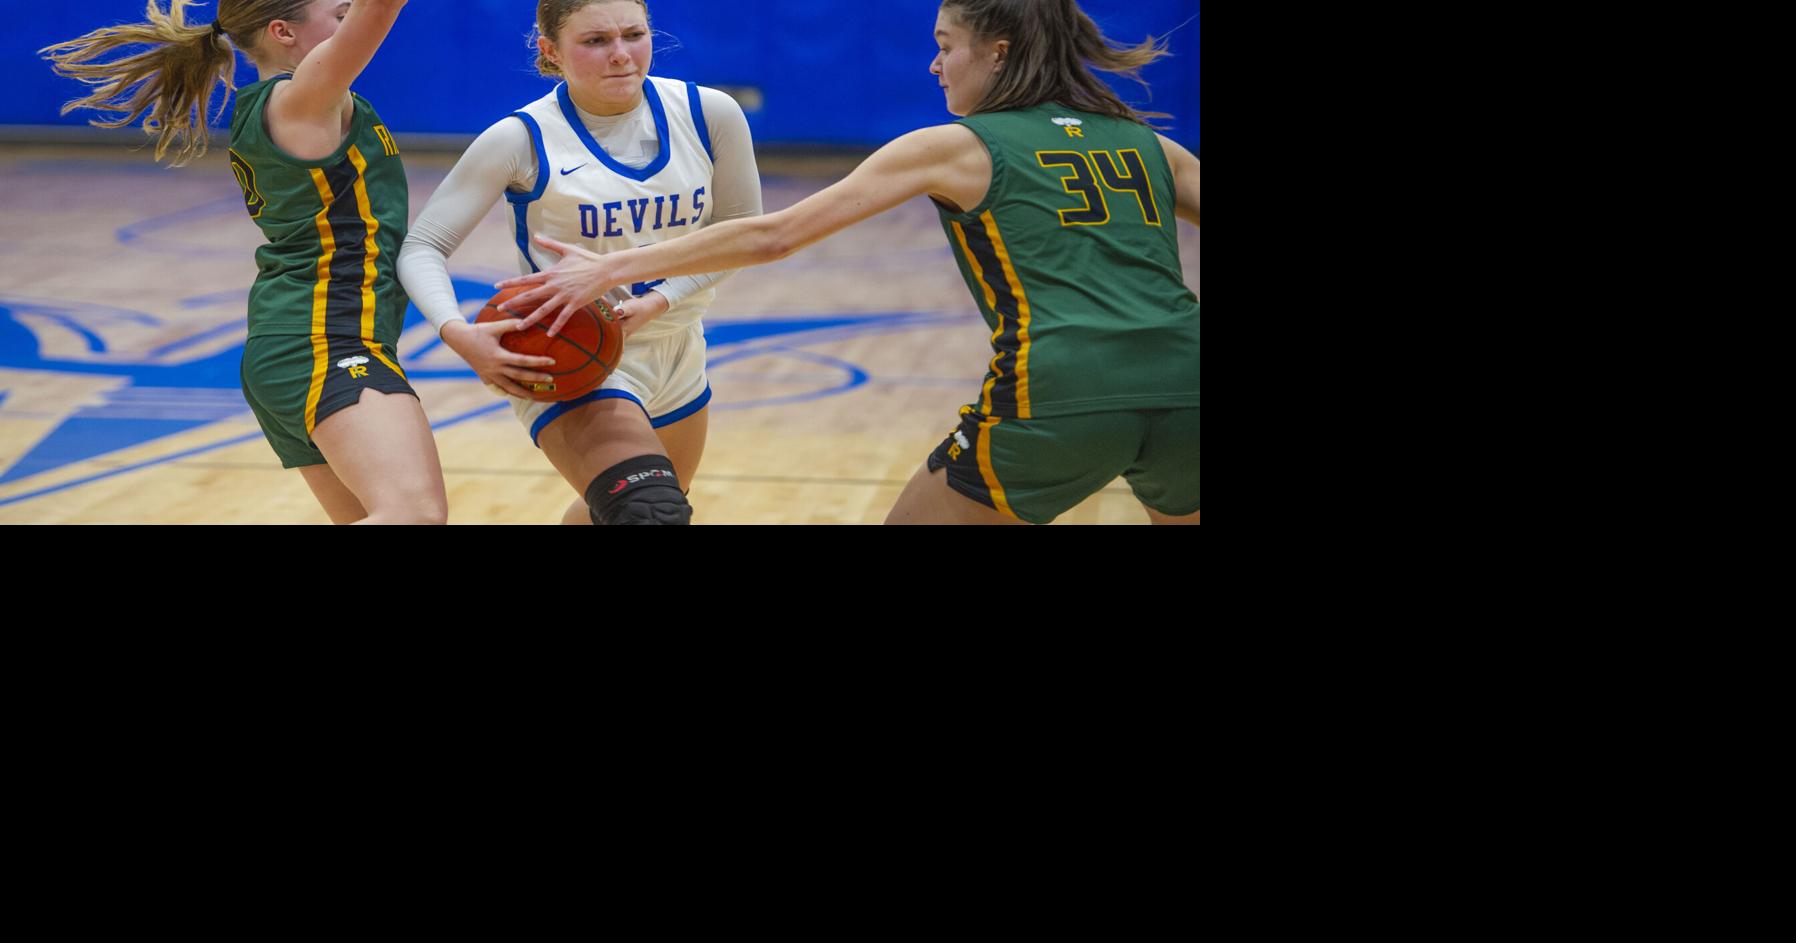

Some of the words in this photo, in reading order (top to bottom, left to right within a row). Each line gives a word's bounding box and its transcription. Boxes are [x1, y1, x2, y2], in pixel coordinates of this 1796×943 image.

[1063, 125, 1085, 138] R
[578, 186, 705, 239] DEVILS
[1035, 148, 1162, 227] 34
